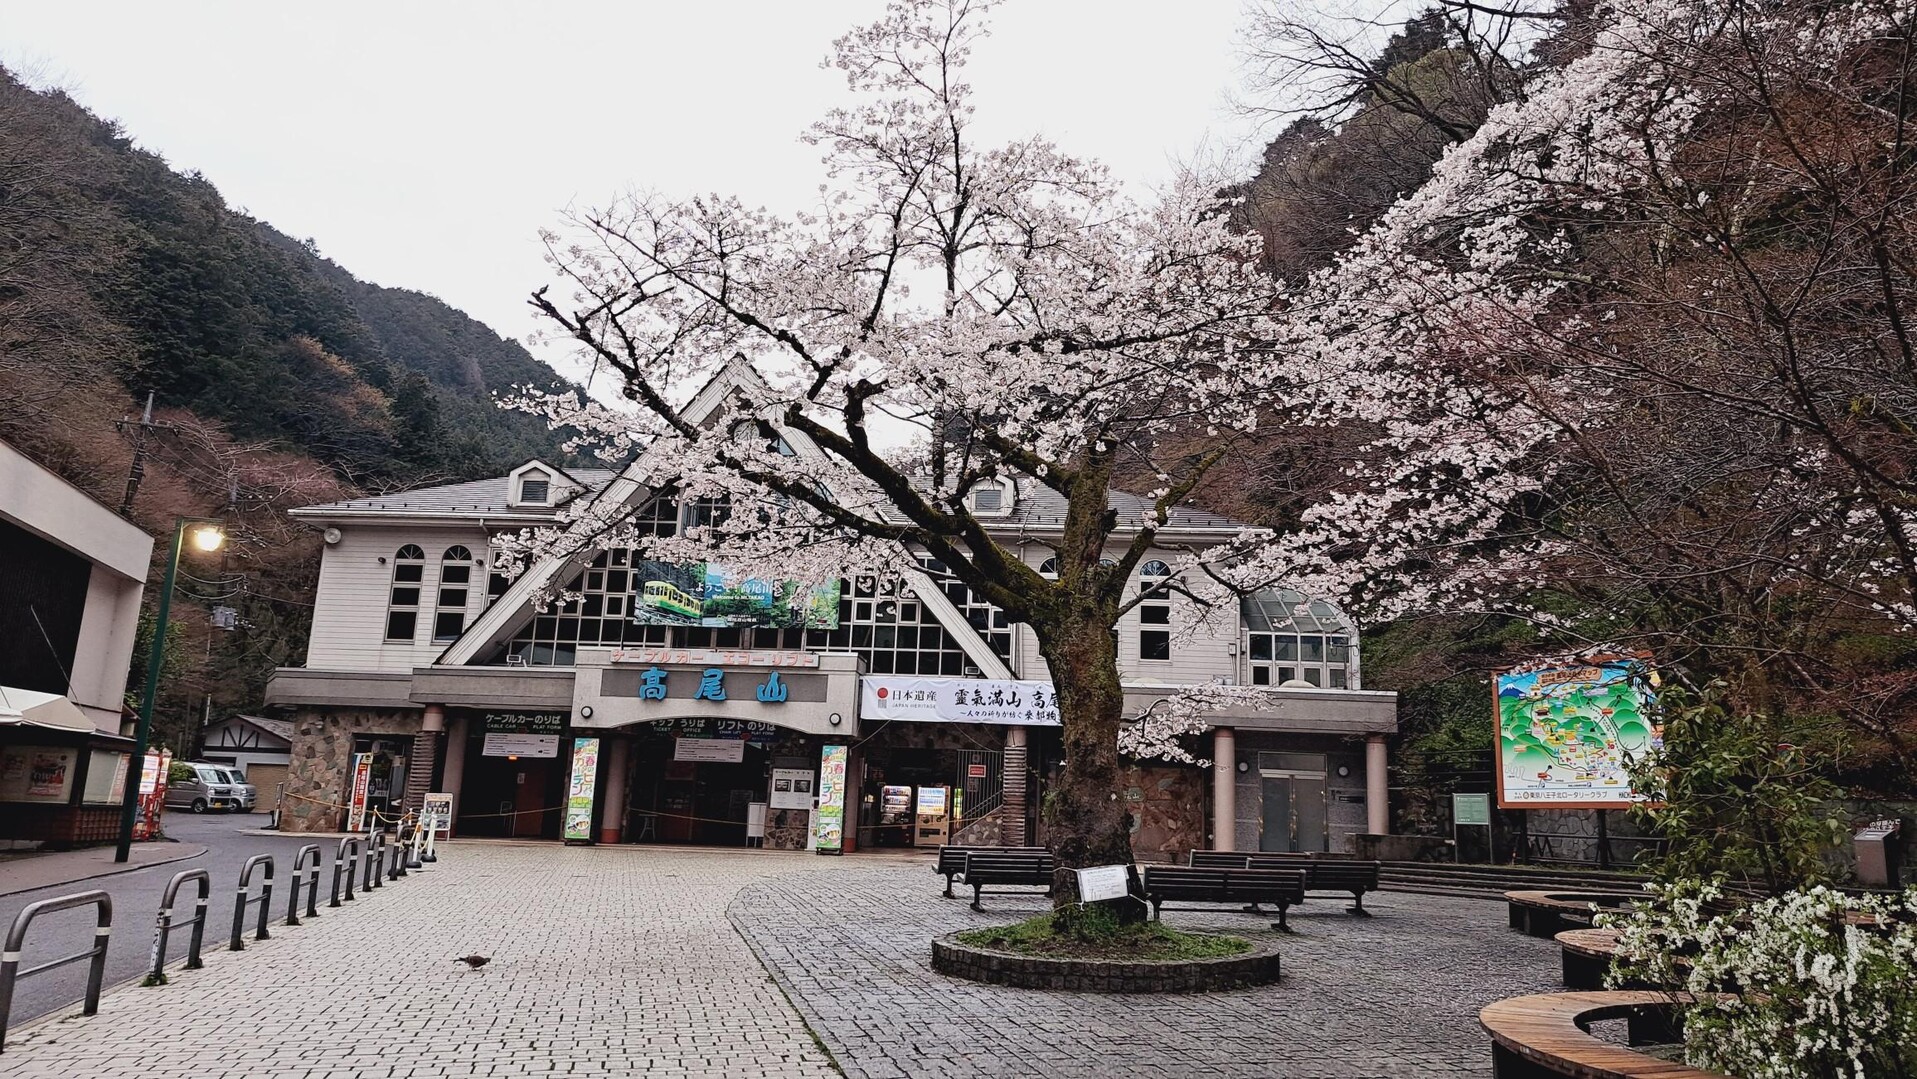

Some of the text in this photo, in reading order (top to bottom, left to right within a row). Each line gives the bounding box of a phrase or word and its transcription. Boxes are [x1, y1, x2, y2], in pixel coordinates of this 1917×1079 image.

[611, 650, 814, 666] ケーブルカー エコーリフト
[892, 689, 937, 701] 日本遺産
[485, 713, 562, 725] ケーブルカーのりば
[717, 720, 745, 730] リフト
[1529, 791, 1608, 799] 東京八王子北ロータリークラブ
